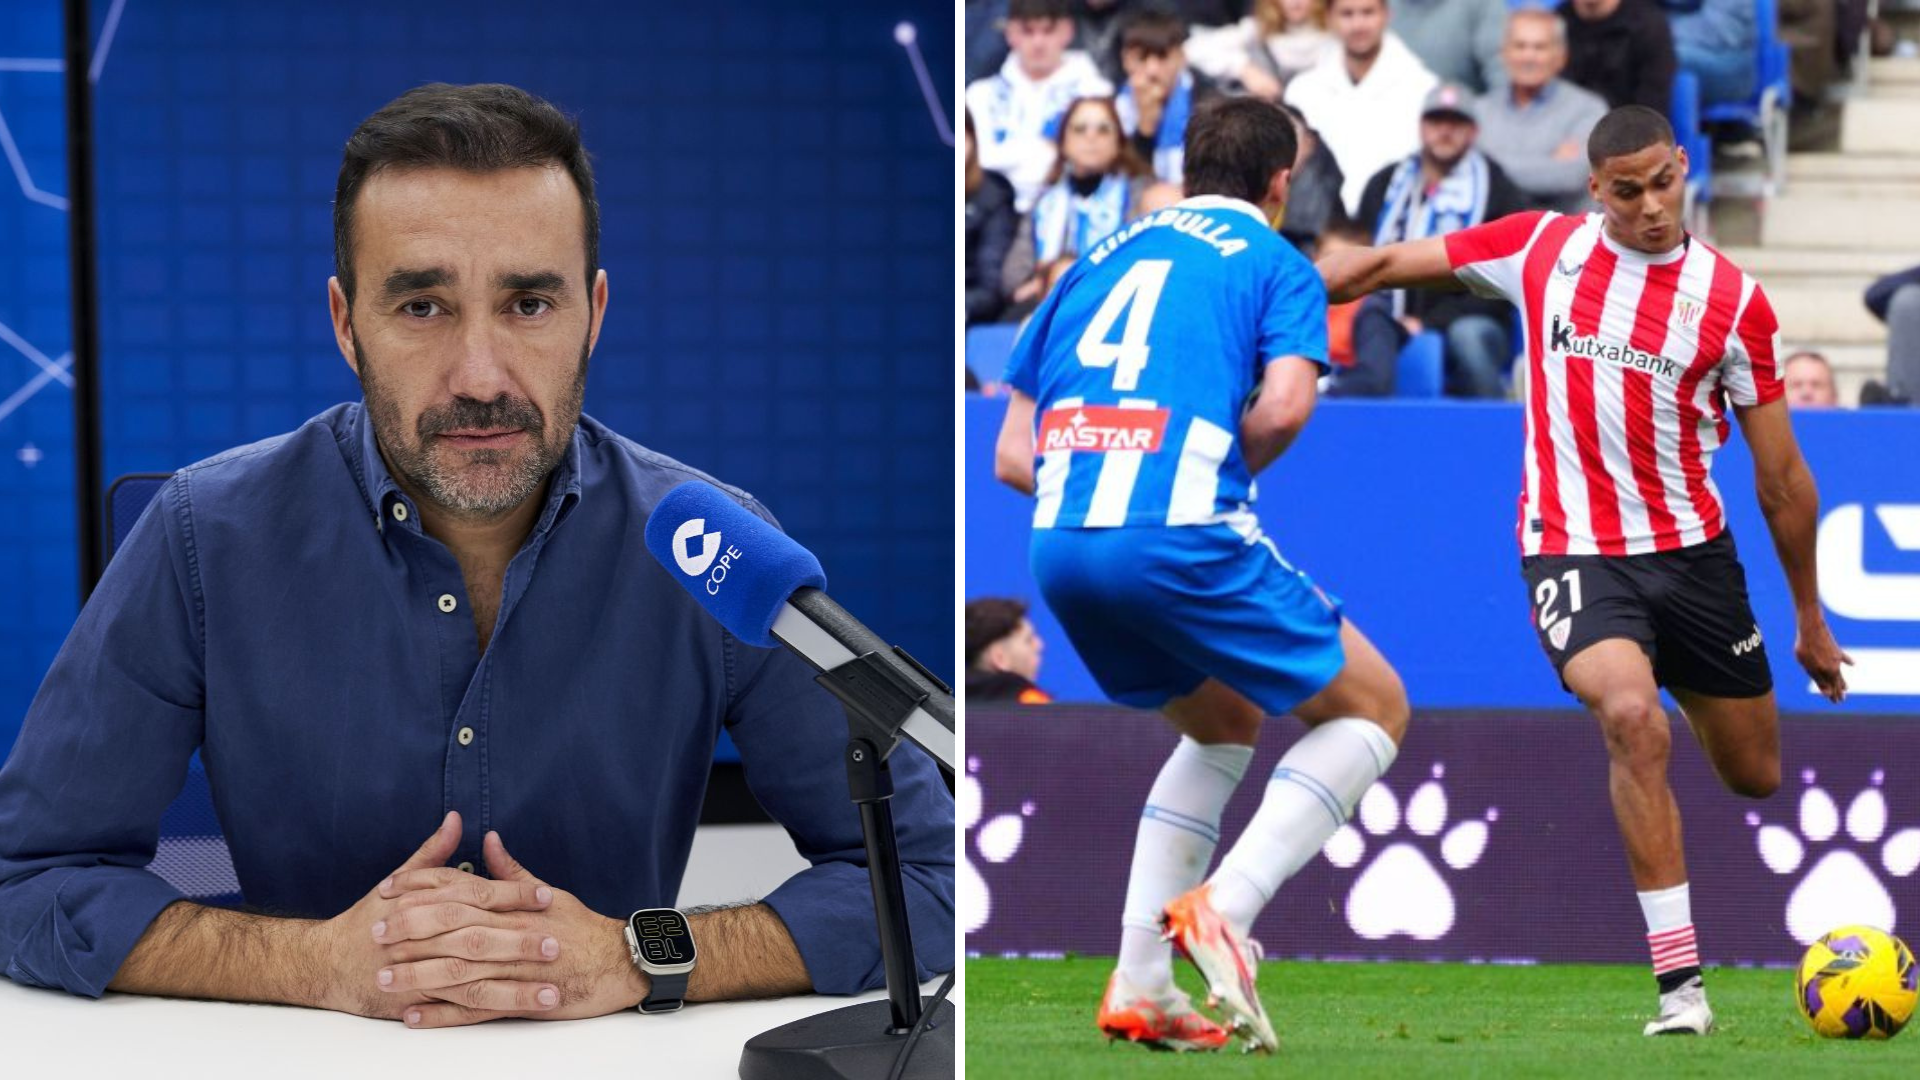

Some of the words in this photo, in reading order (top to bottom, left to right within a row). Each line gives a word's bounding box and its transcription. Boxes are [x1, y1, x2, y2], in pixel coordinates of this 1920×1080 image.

[1075, 258, 1173, 391] 4
[1551, 315, 1676, 378] Kutxabank
[1045, 425, 1154, 449] RASTAR
[706, 544, 743, 596] COPE
[1535, 569, 1582, 631] 21
